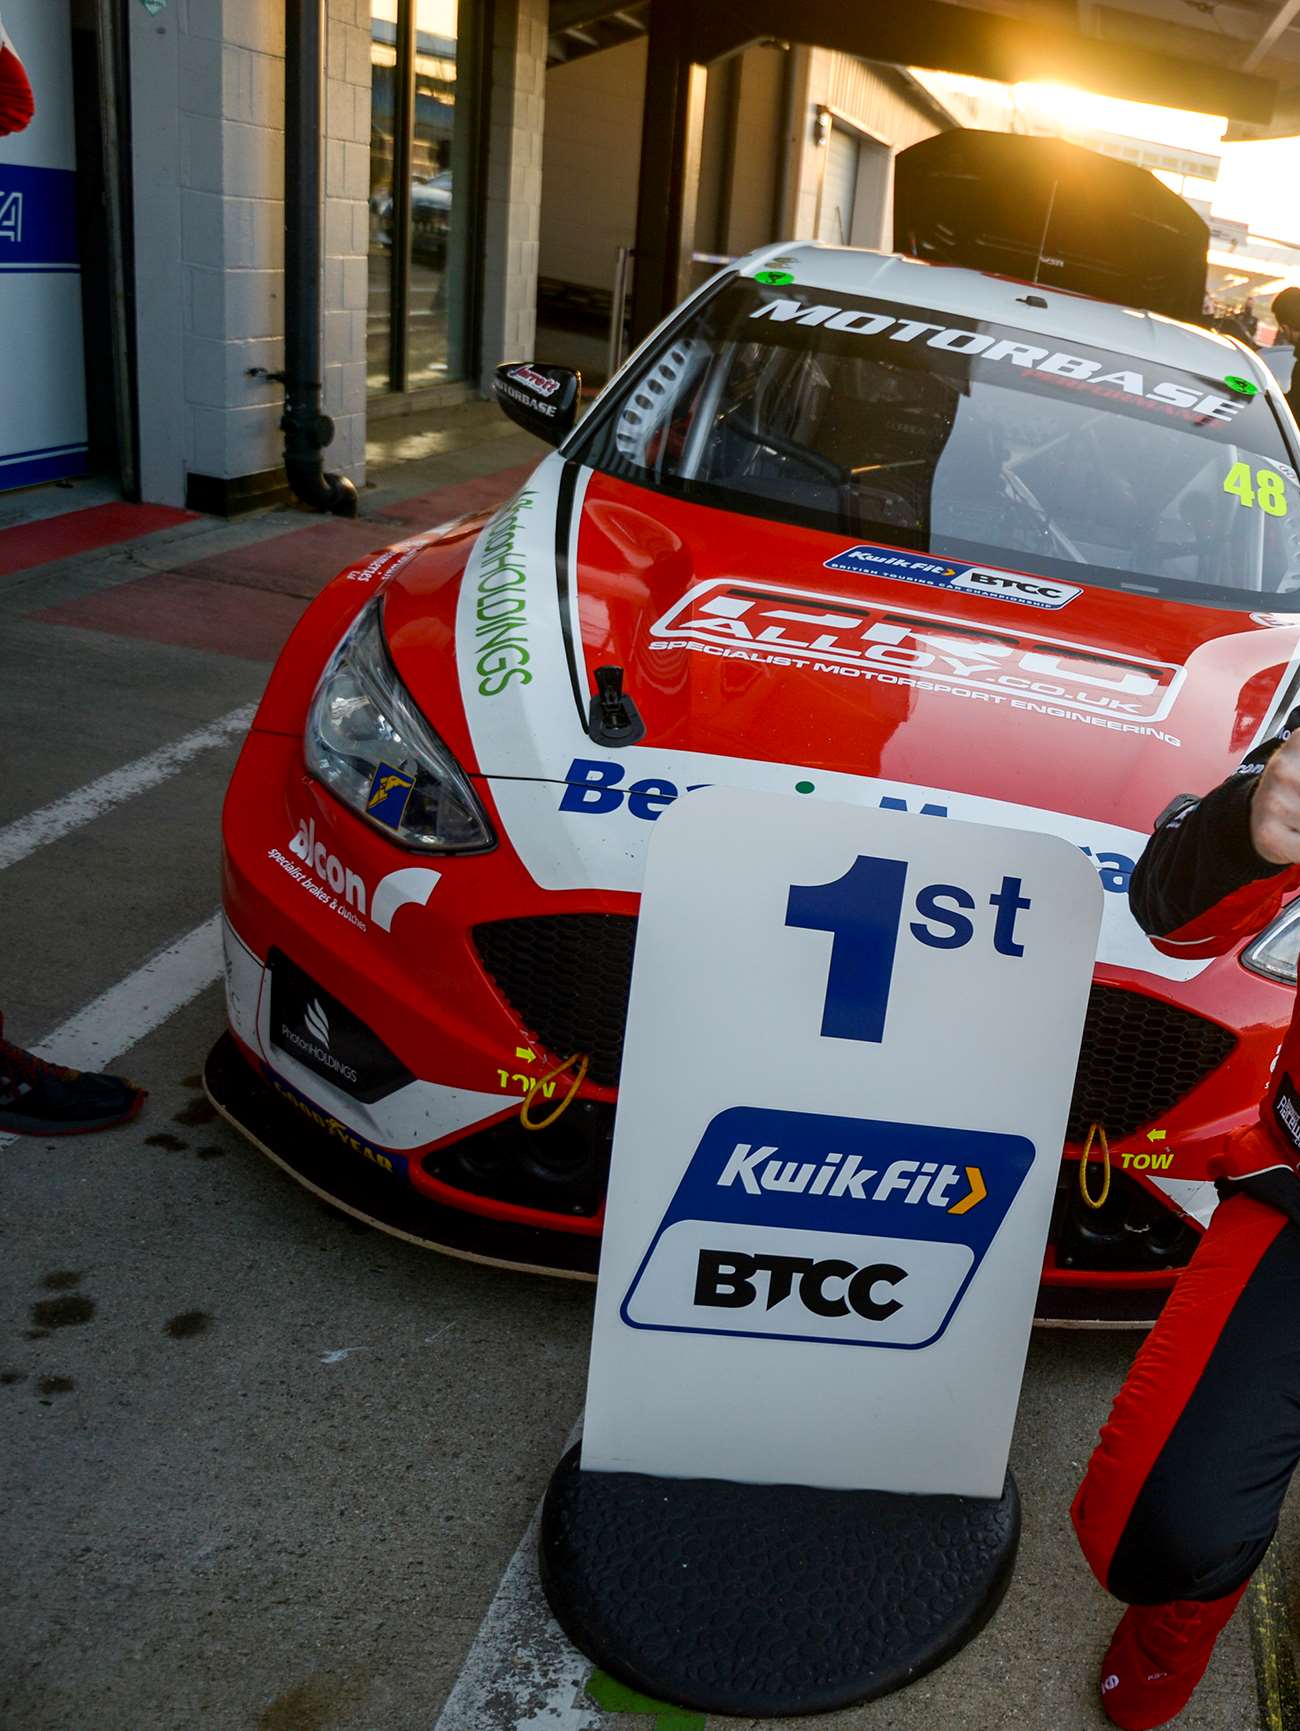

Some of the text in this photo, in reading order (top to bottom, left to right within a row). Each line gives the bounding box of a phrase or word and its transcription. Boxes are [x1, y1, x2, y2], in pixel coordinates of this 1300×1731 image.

[749, 299, 1245, 422] MOTORBASE
[1223, 462, 1288, 517] 48
[830, 563, 878, 577] BRITISH
[881, 571, 934, 586] TOURING
[938, 582, 963, 593] CAR
[969, 571, 1063, 599] BTCC
[698, 587, 1164, 696] PRO
[648, 640, 1182, 748] SPECIALIST MOTORSPORT ENGINEERING
[267, 847, 307, 883] specialist
[302, 876, 331, 905] brakes
[328, 899, 339, 911] &
[288, 816, 367, 916] alcon
[784, 854, 1032, 1044] 1st
[1120, 1153, 1175, 1170] TOW
[693, 1248, 909, 1322] BTCC
